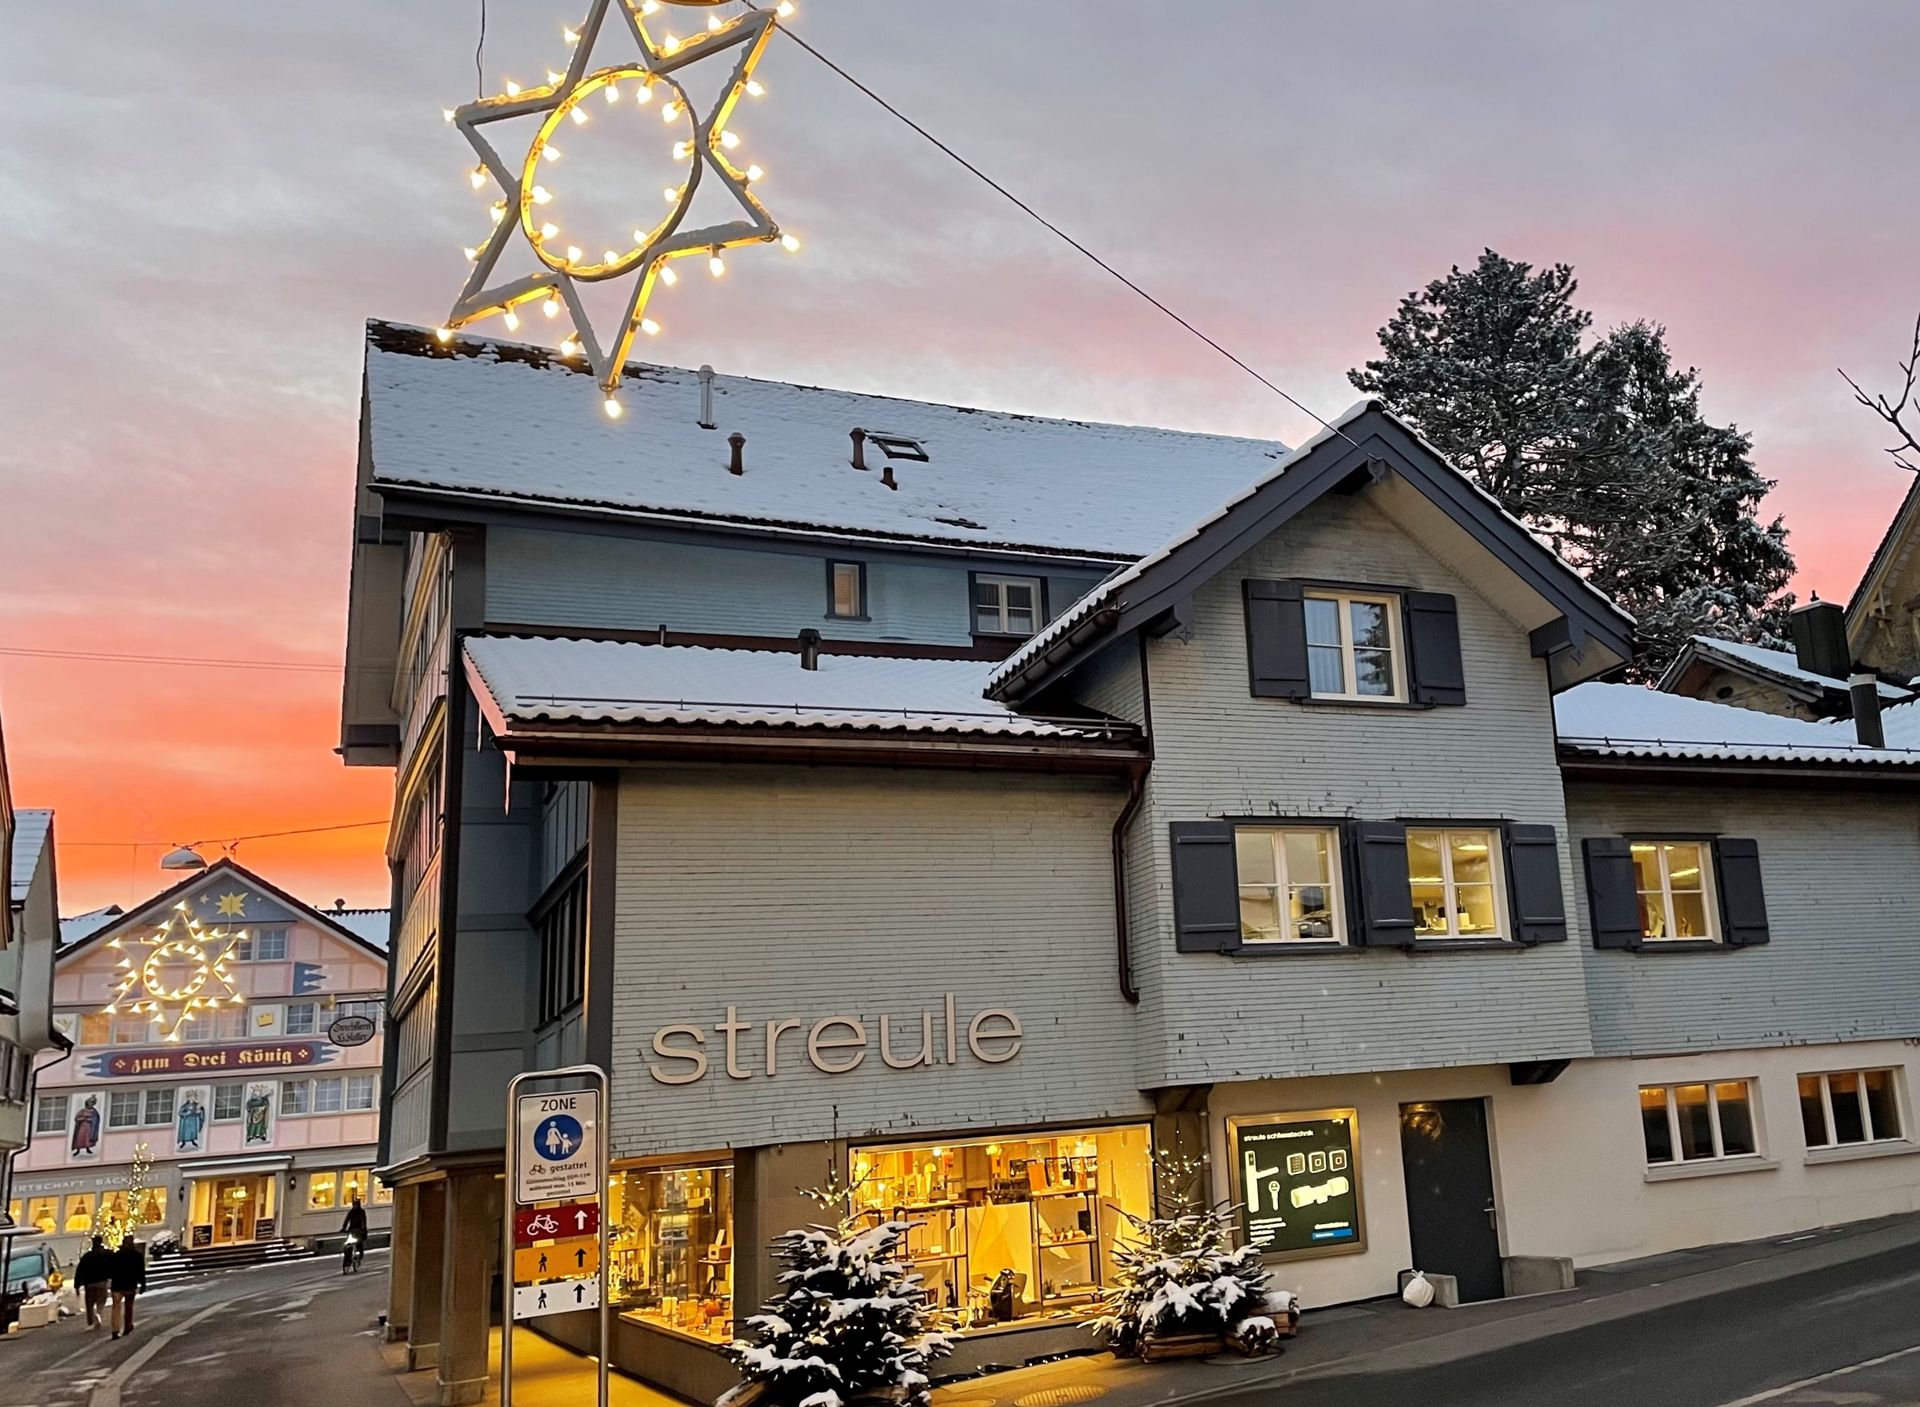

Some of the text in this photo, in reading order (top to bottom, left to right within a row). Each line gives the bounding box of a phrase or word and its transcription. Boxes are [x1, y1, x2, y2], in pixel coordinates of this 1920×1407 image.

[649, 992, 1023, 1085] streule
[183, 1051, 227, 1067] Drei
[238, 1048, 293, 1065] König
[540, 1097, 577, 1112] ZONE
[549, 1162, 587, 1174] gestattet
[13, 1180, 85, 1193] IRTSCHAFT
